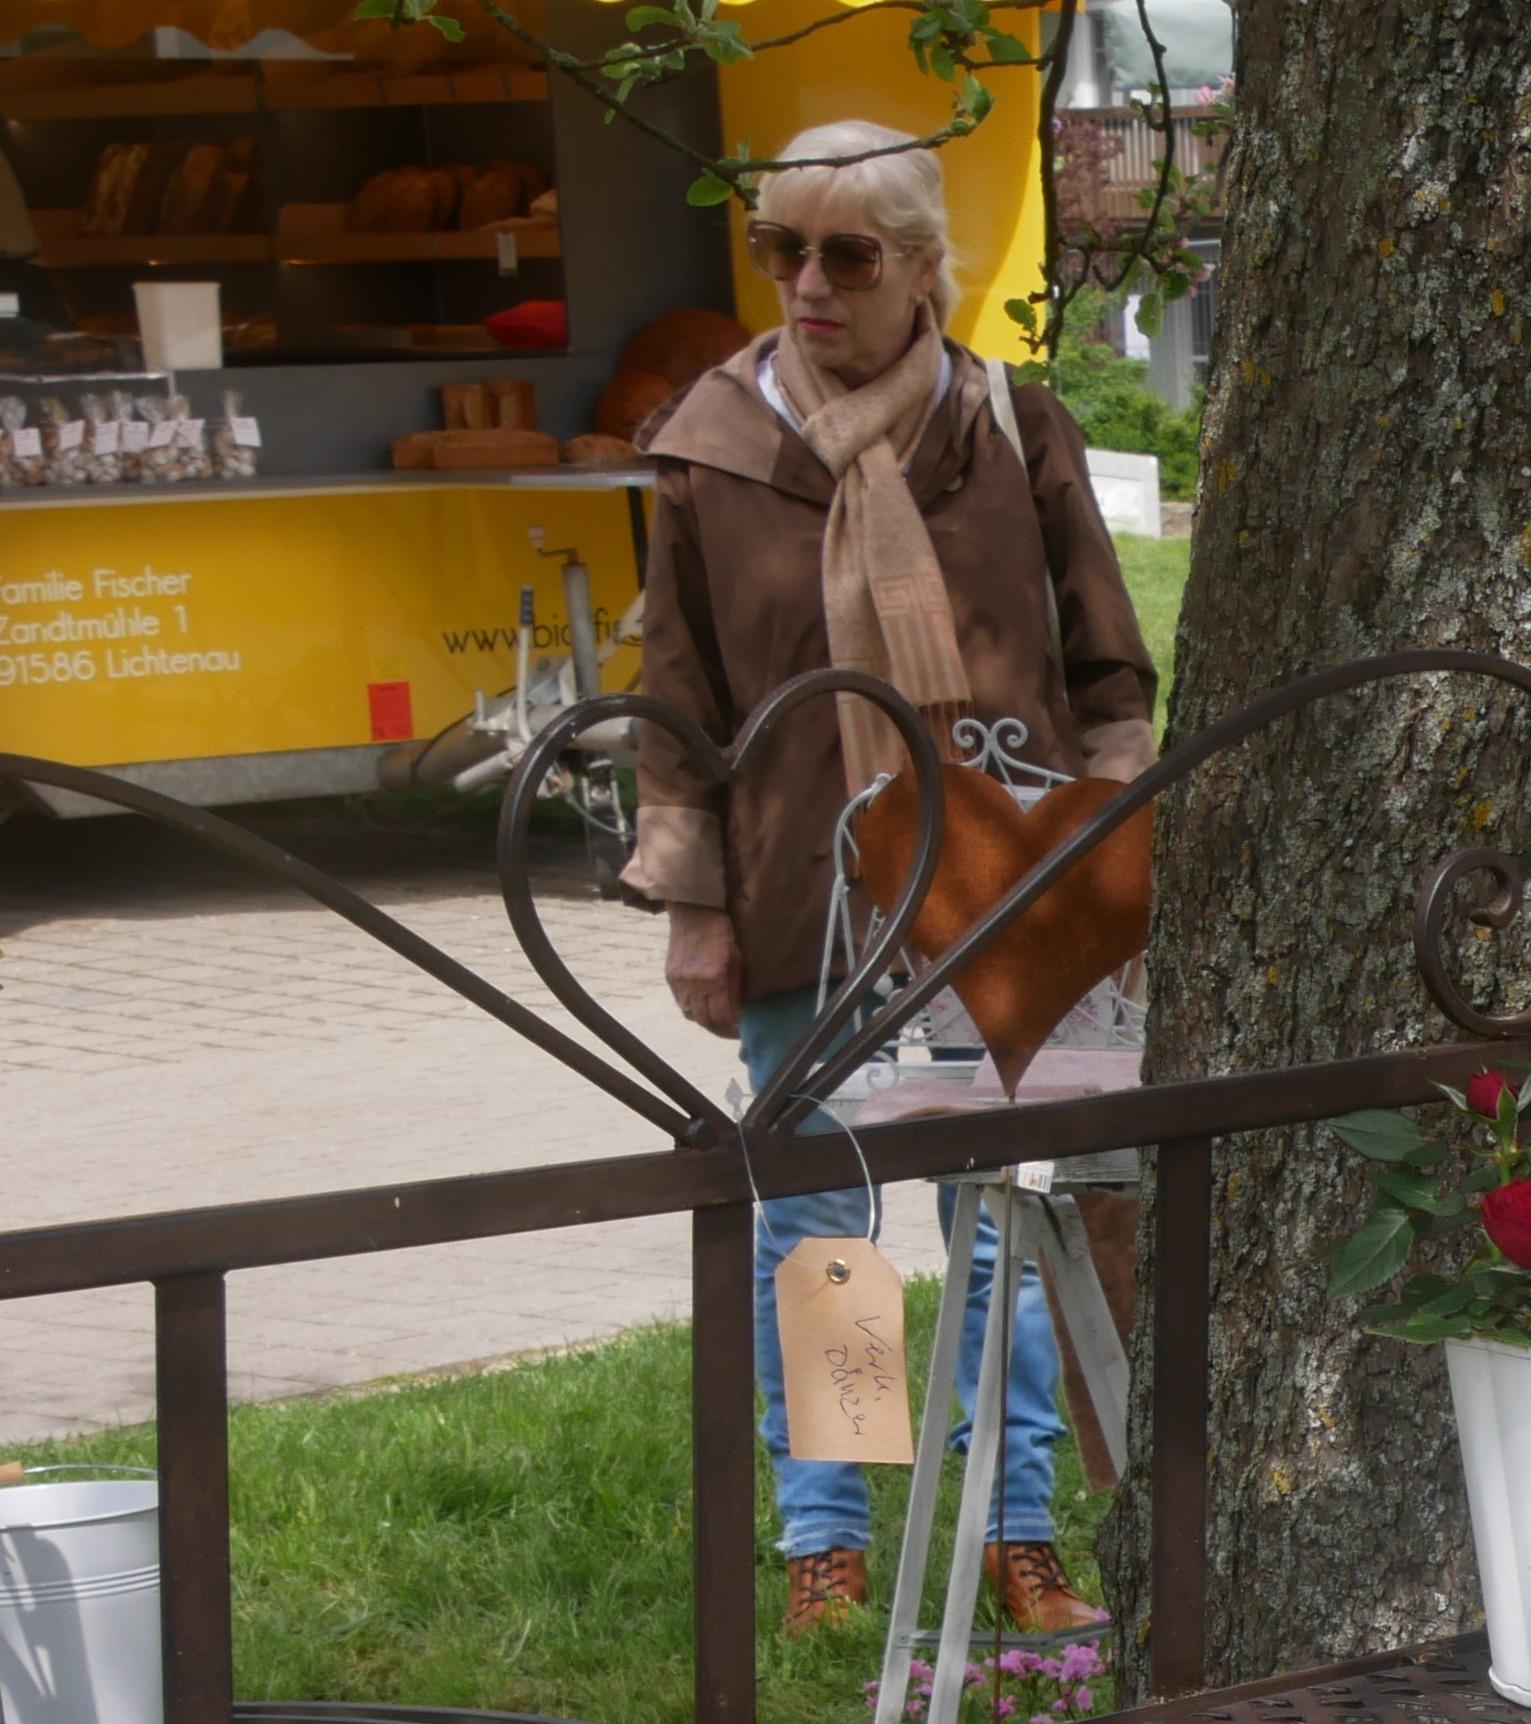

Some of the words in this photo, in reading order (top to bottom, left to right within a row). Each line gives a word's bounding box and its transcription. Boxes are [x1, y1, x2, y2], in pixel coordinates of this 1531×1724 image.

[0, 570, 84, 606] amilie
[93, 564, 192, 599] Fischer
[0, 606, 160, 645] Zandtmühle
[174, 605, 189, 634] 1
[0, 650, 96, 686] 91586
[106, 645, 241, 679] Lichtenau
